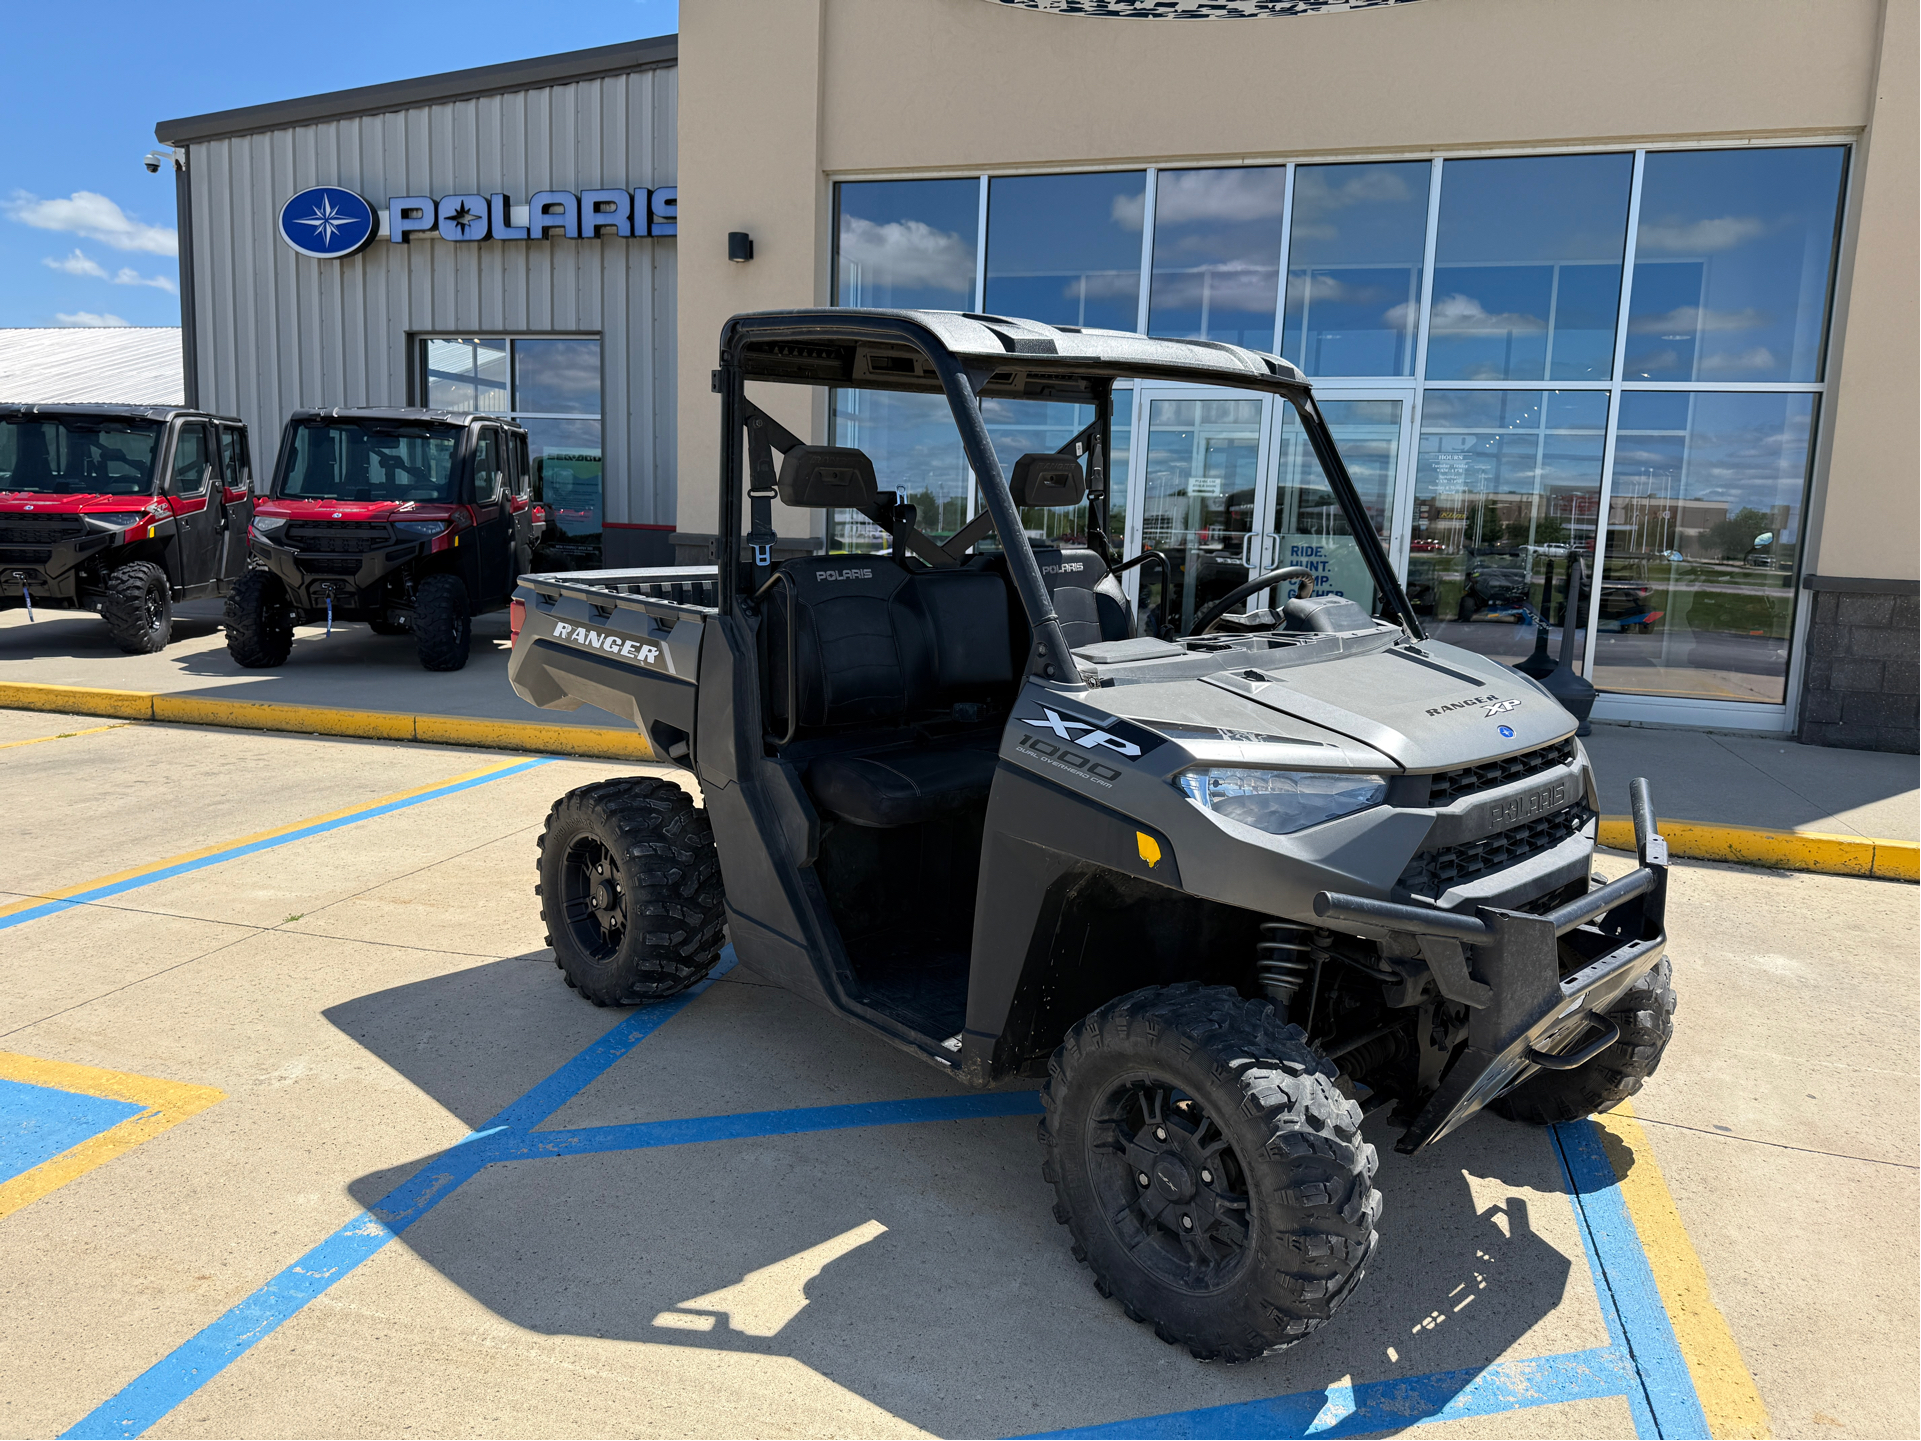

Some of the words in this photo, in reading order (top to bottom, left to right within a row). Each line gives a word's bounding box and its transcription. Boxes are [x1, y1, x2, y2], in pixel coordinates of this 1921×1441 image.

[389, 186, 678, 244] POLARIS
[1042, 562, 1084, 575] POLARIS
[1291, 545, 1327, 557] RIDE.
[815, 567, 873, 582] POLARIS
[553, 621, 660, 664] RANGER
[1425, 694, 1499, 717] RANGER
[1479, 698, 1522, 718] XP
[1018, 707, 1142, 757] XP
[1015, 746, 1039, 759] DUAL
[1040, 756, 1089, 780] OVERHEAD
[1090, 777, 1113, 789] CAM
[1019, 733, 1122, 781] 1000
[1488, 782, 1566, 829] POLARIS
